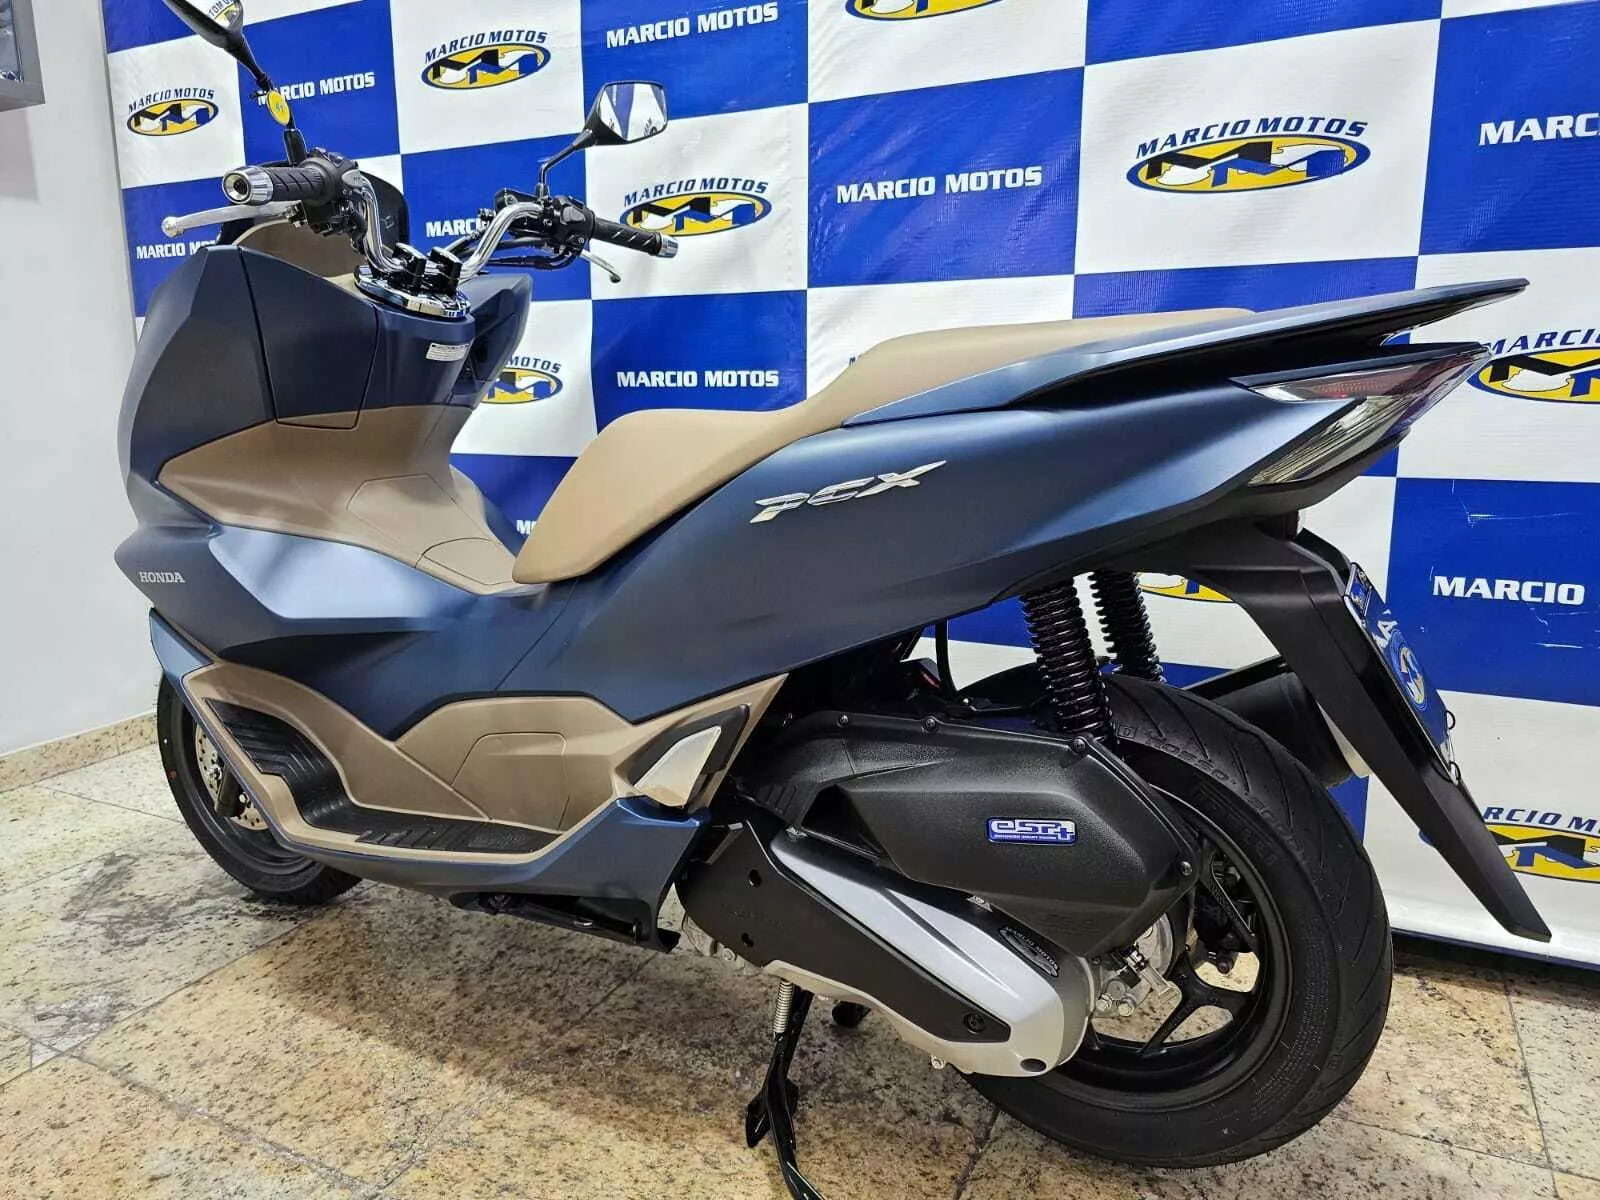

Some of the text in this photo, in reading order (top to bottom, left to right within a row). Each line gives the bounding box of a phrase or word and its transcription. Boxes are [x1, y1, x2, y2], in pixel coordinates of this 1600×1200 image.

[606, 2, 778, 48] MARCIO MOTOS
[425, 29, 548, 64] MARCIO MOTOS
[319, 72, 375, 95] MOTOS
[128, 87, 214, 114] MARCIO MOTOS
[1136, 116, 1368, 159] MARCIO MOTOS
[1479, 112, 1600, 146] MARC
[624, 177, 769, 207] MARCIO MOTOS
[837, 166, 1042, 203] MARCIO MOTOS
[426, 217, 489, 238] MARCI
[136, 242, 186, 259] MARCIO
[1491, 328, 1600, 355] MARCI
[617, 370, 779, 387] MARCIO MOTOS
[749, 459, 947, 524] PCX
[139, 571, 186, 583] HONDA
[1432, 575, 1586, 606] MARCIO
[1483, 806, 1563, 827] RCIO
